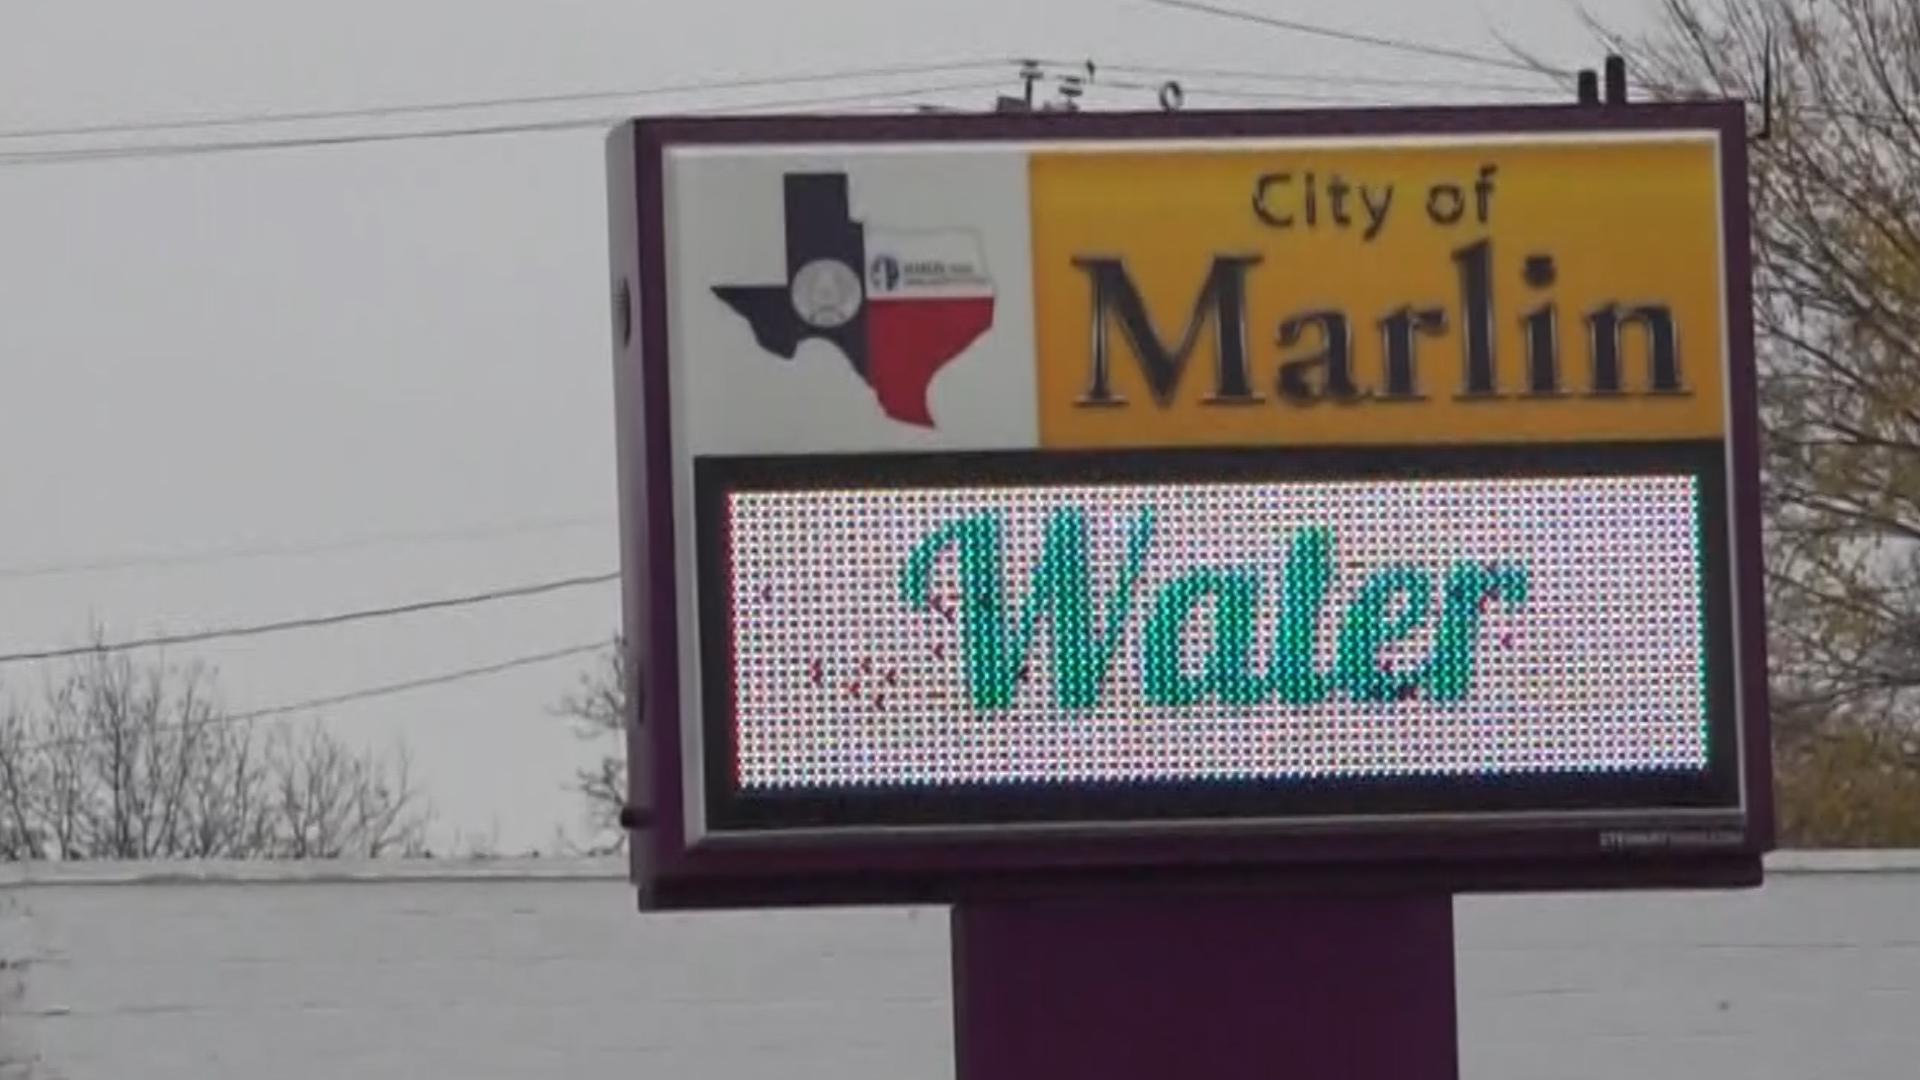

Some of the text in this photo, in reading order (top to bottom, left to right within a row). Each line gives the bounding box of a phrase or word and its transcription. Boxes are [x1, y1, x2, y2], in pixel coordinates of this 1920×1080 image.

[1251, 164, 1498, 242] City of
[1070, 237, 1693, 409] Marlin
[900, 504, 1528, 711] Water
